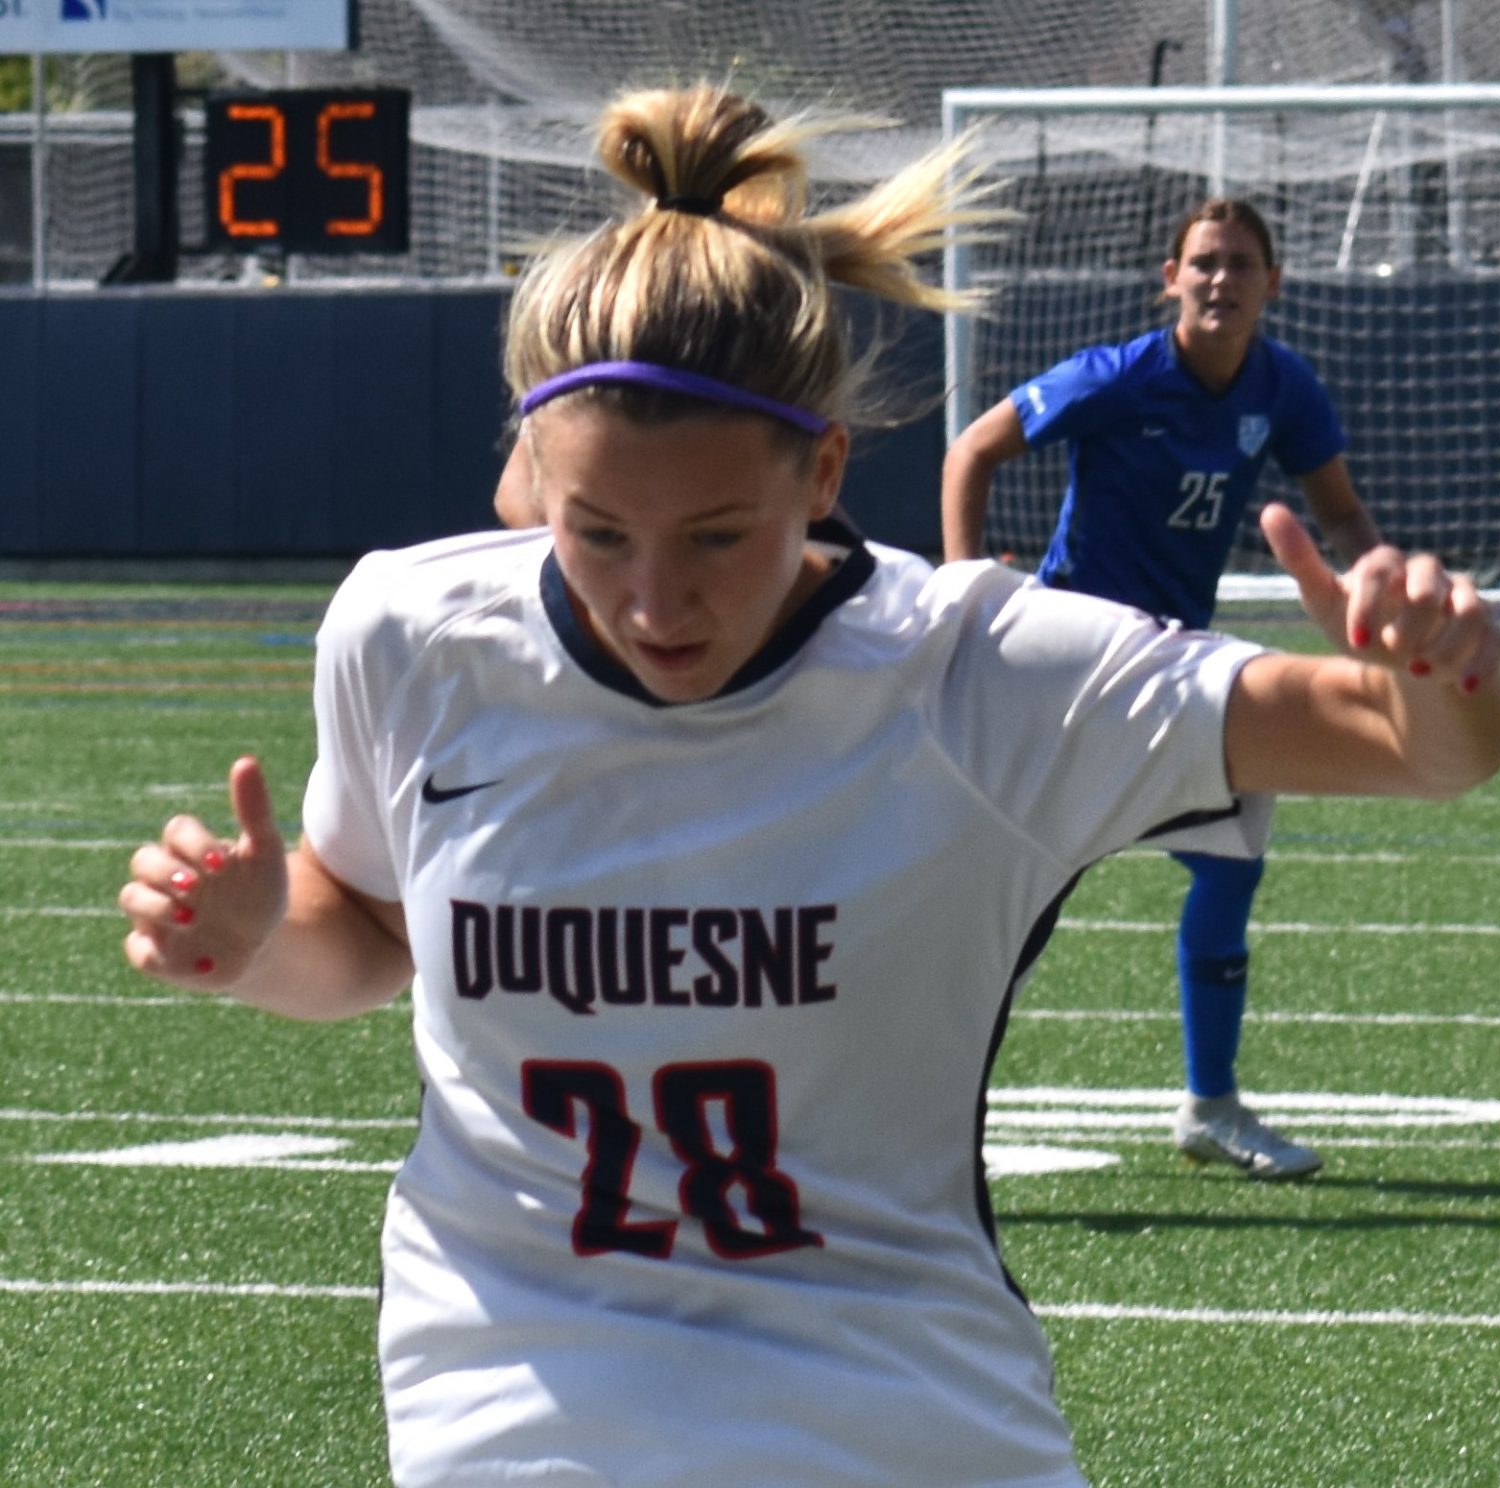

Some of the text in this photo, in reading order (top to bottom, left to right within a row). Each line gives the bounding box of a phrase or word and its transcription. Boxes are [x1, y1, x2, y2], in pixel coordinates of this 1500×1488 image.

[218, 102, 383, 237] 25
[1167, 472, 1229, 529] 25
[450, 899, 837, 1015] DUQUESNE
[520, 1058, 824, 1260] 28
